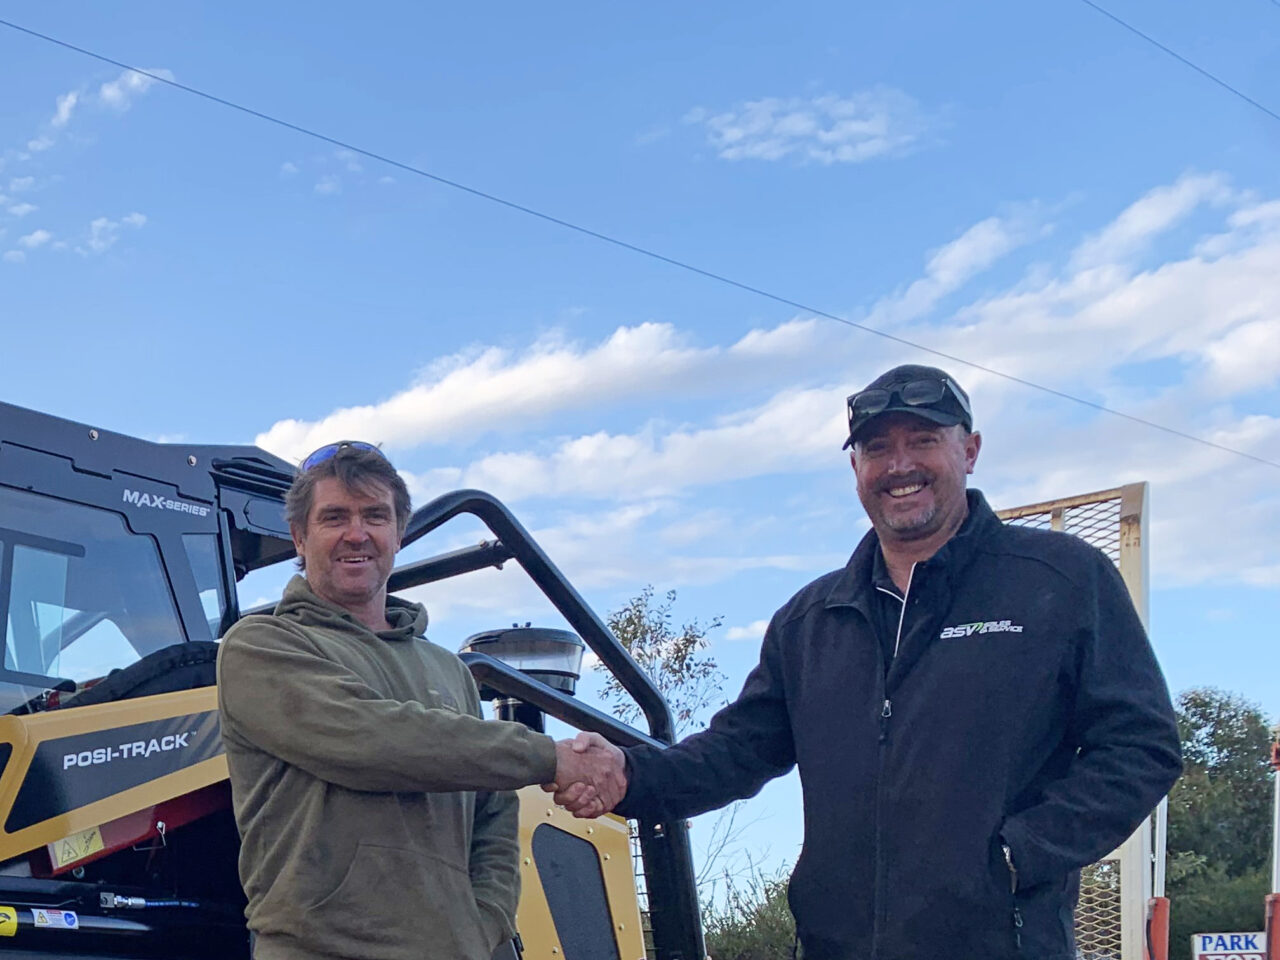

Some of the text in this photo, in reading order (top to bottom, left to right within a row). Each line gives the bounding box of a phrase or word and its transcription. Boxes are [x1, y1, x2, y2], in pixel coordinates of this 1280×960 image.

[123, 489, 207, 517] MAX-SERIES
[63, 732, 189, 770] POSI-TRACK
[1201, 934, 1259, 952] PARK
